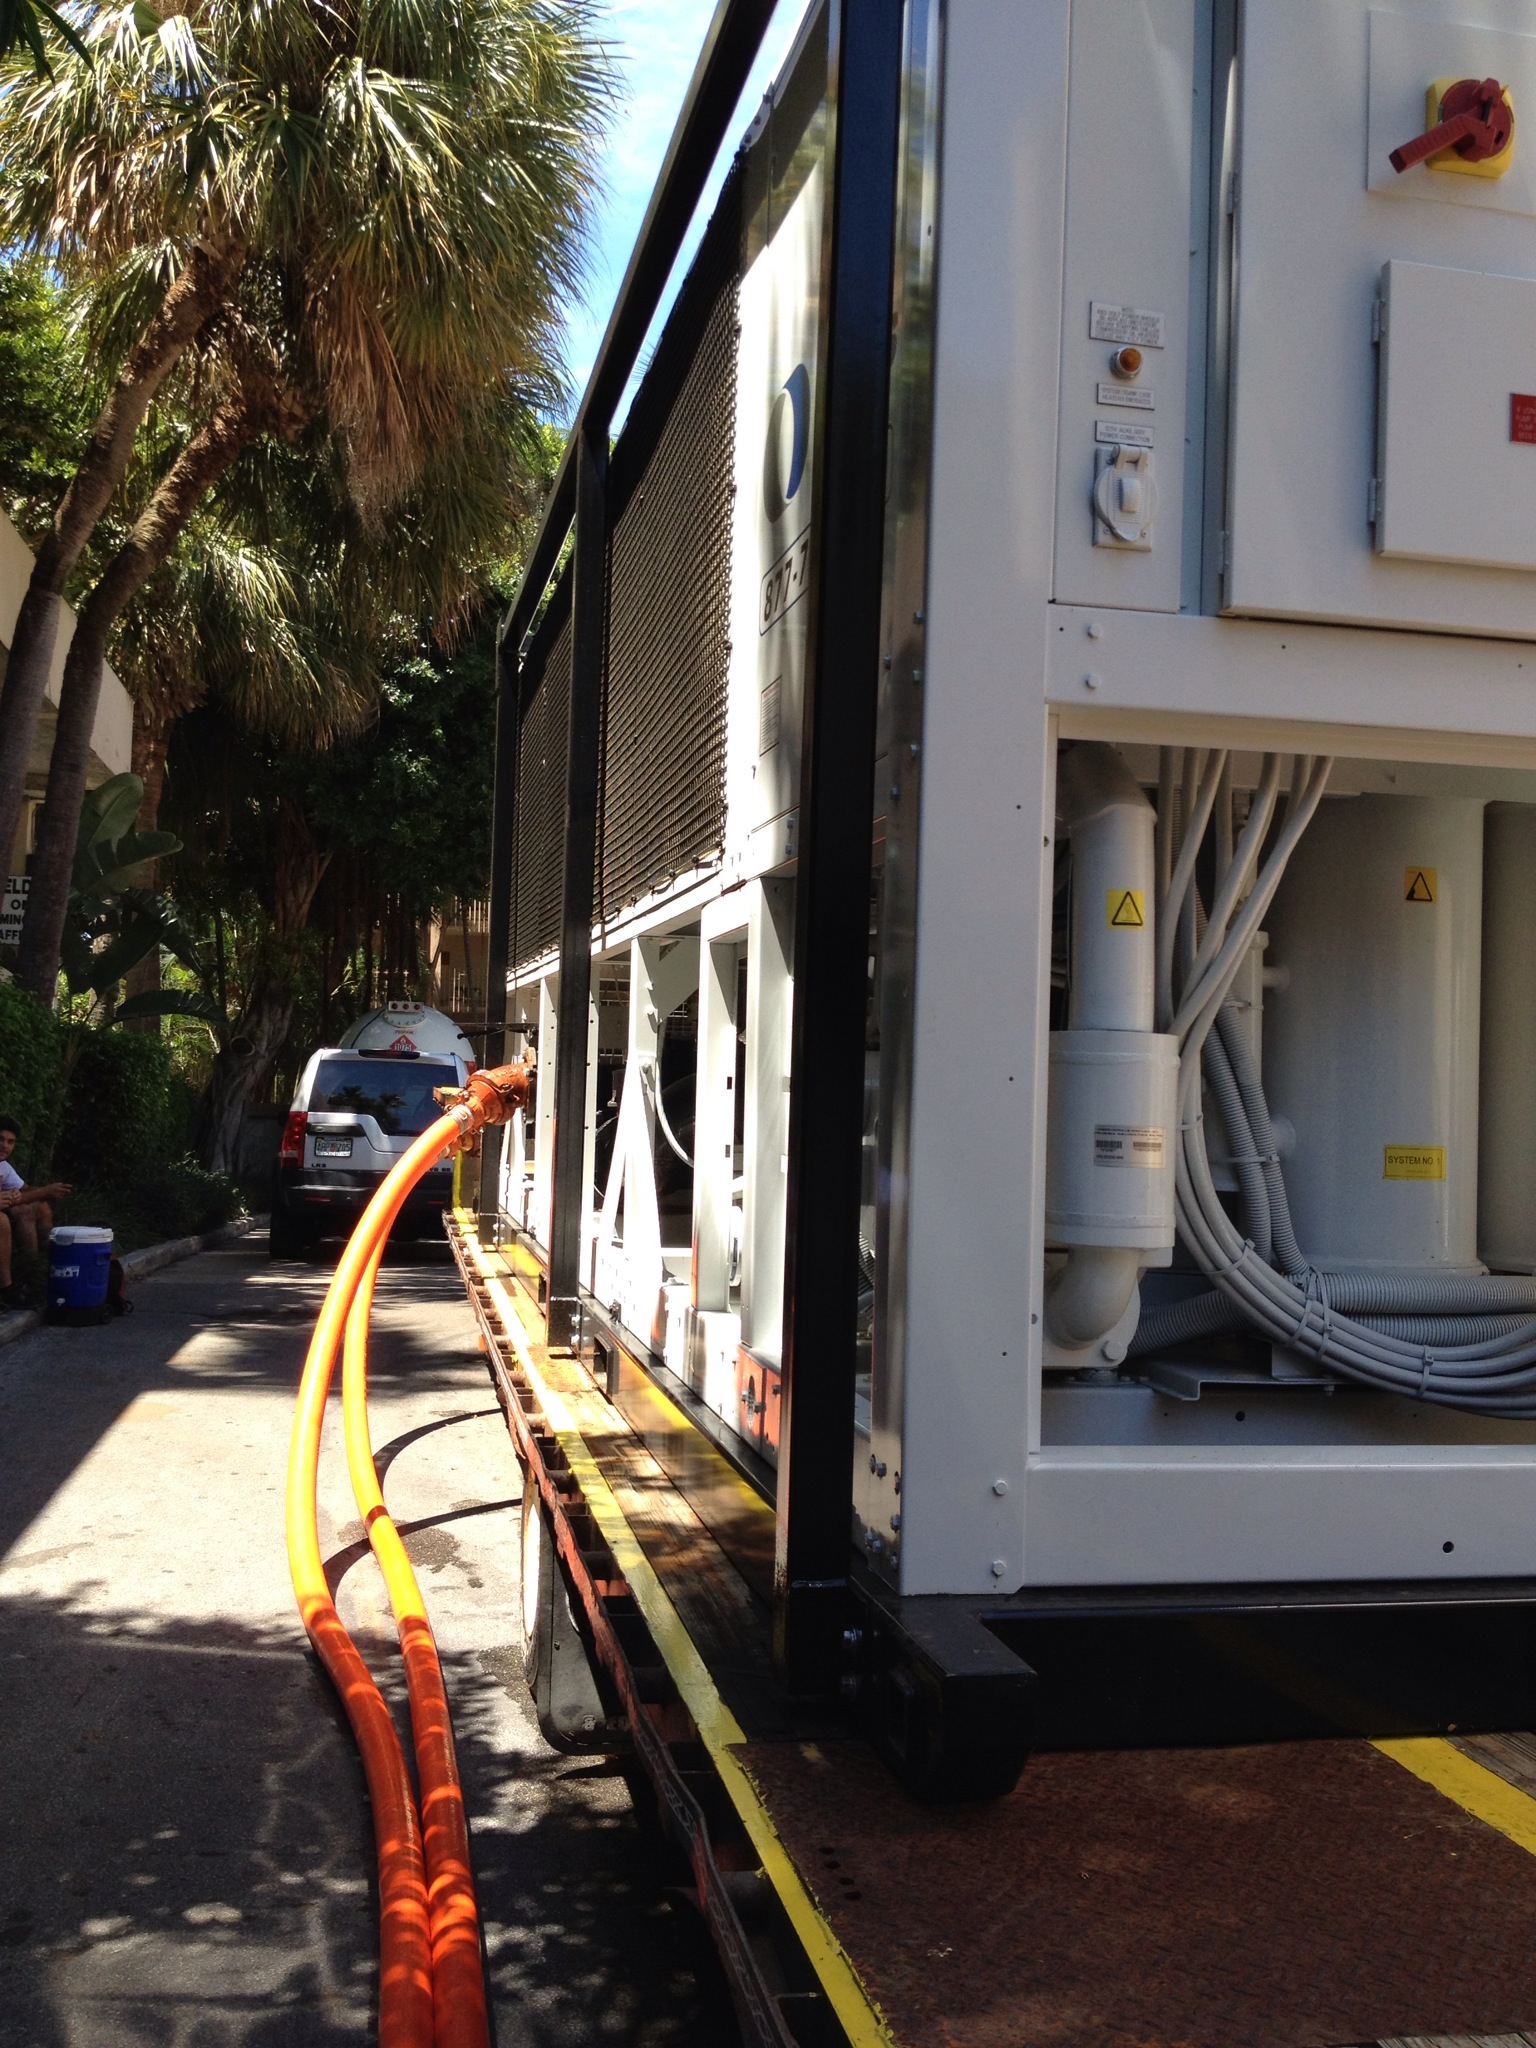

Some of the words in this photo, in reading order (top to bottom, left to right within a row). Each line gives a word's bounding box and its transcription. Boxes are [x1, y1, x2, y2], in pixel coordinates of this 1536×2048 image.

[5, 878, 32, 894] ELD
[1387, 1155, 1421, 1165] SYSTEM
[1422, 1156, 1434, 1165] NO
